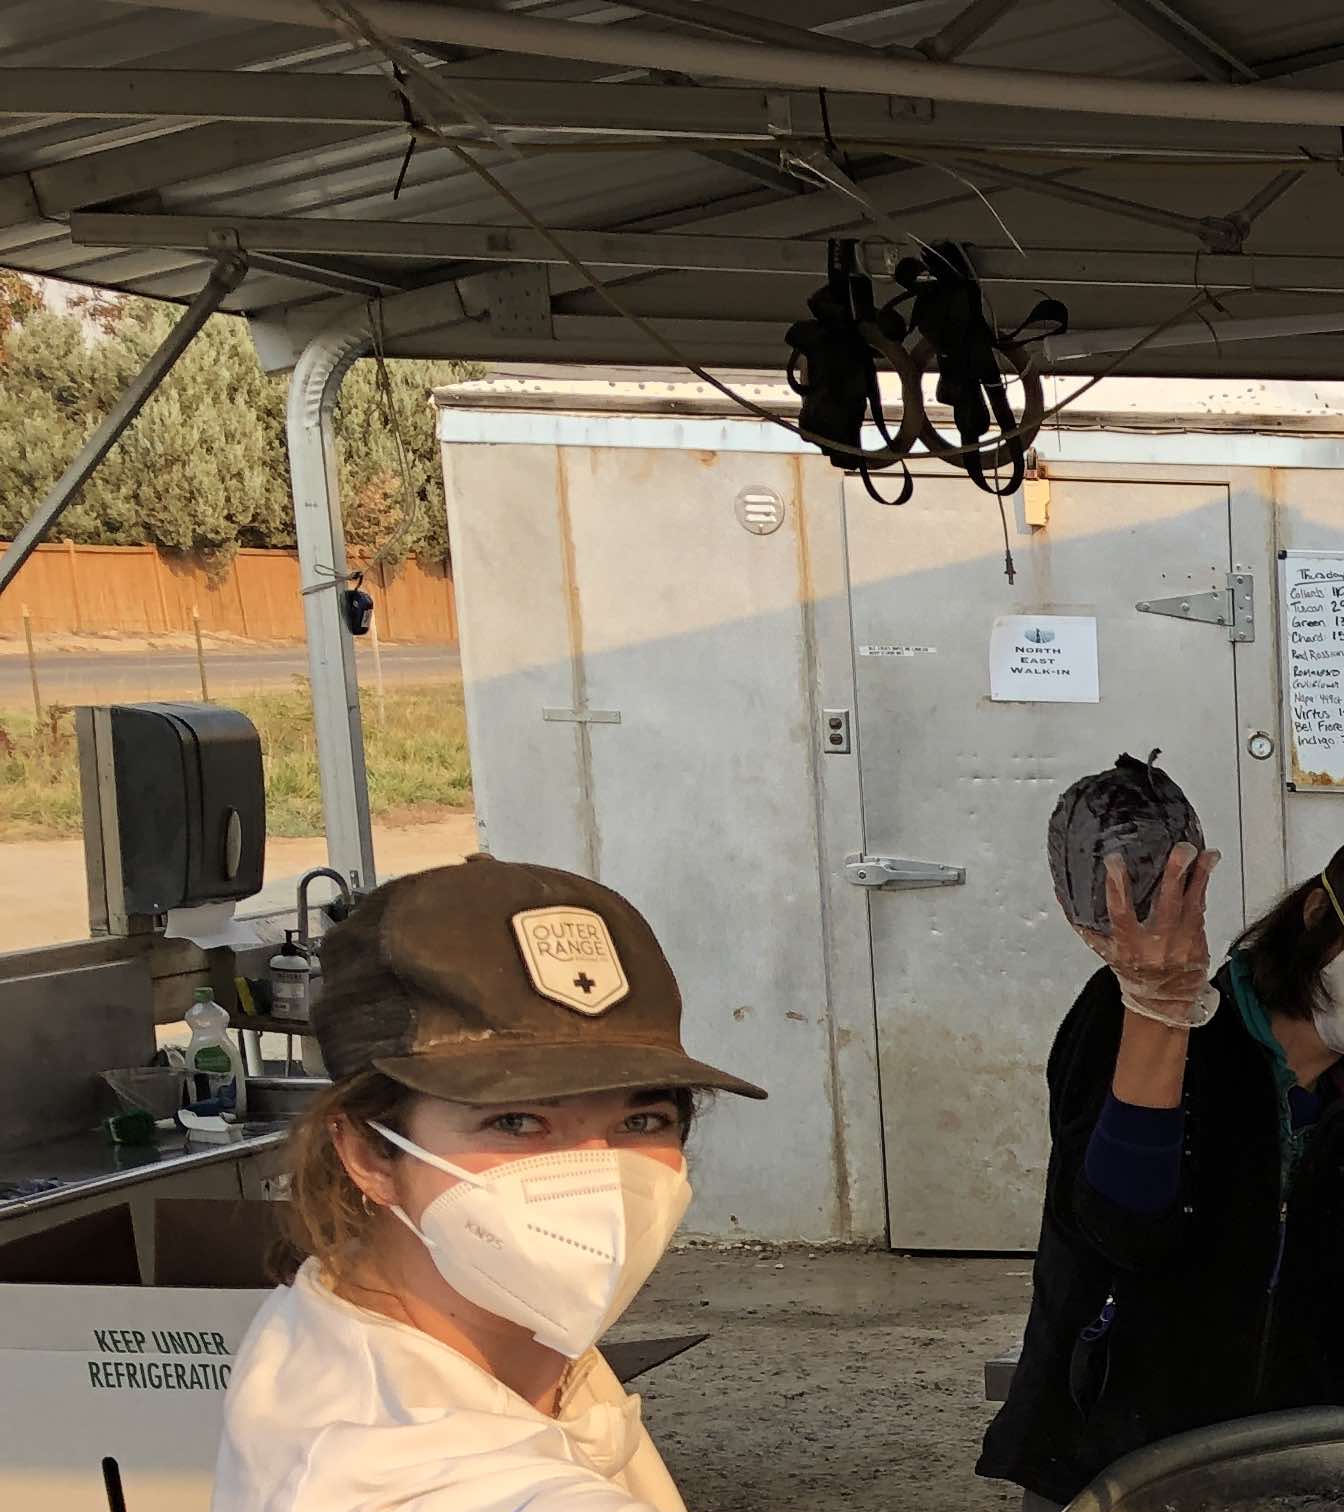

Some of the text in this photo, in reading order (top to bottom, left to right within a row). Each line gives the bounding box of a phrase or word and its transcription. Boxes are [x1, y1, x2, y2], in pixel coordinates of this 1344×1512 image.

[1292, 616, 1326, 628] Green
[1297, 735, 1336, 750] Indigo
[532, 922, 601, 941] OUTER
[536, 942, 608, 962] RANGE
[94, 1329, 231, 1356] KEEP UNDER
[88, 1361, 232, 1391] REFRIGERATIO
